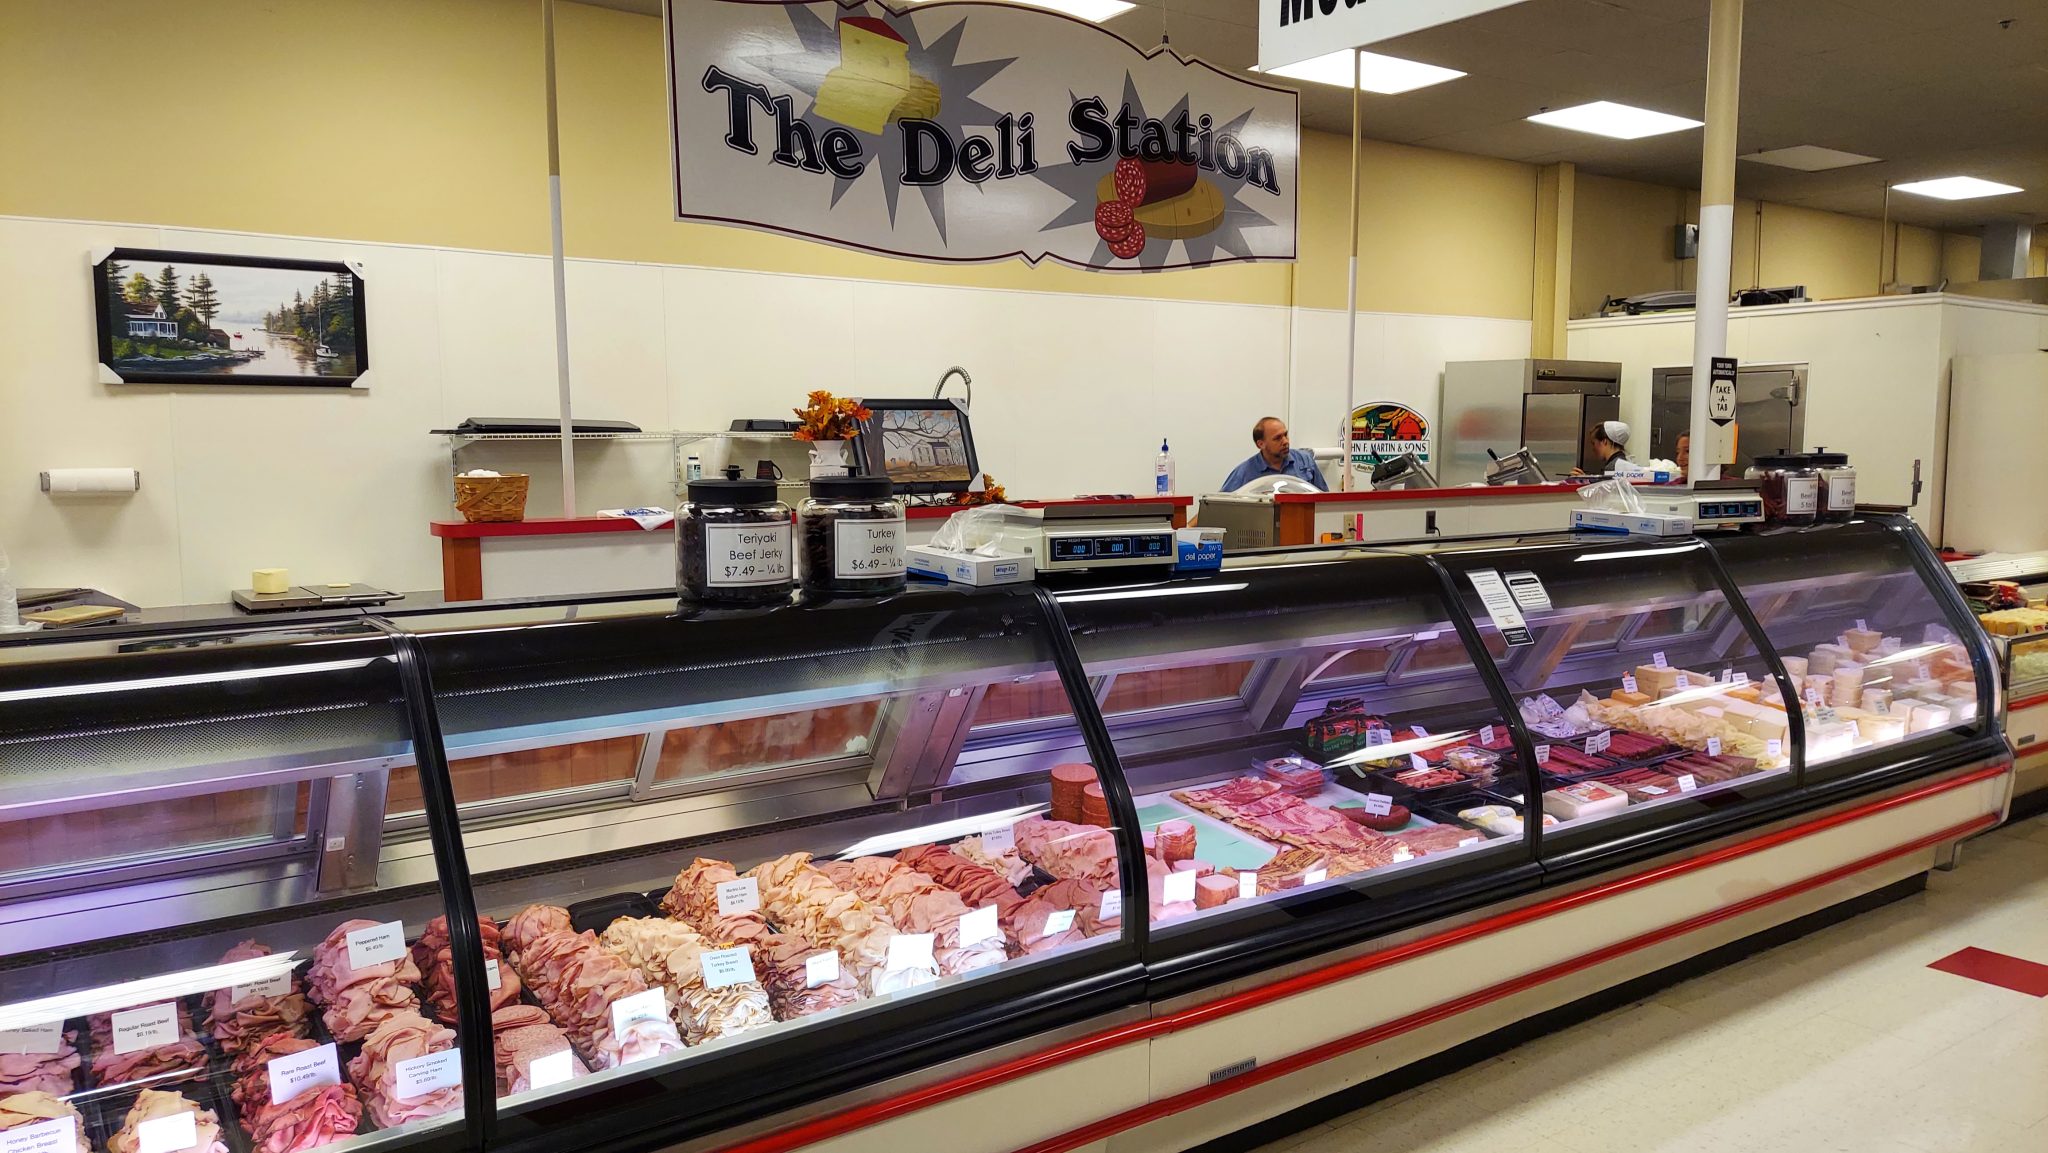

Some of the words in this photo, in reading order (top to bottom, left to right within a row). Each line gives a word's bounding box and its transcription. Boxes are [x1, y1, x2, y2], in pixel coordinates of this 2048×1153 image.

[701, 64, 866, 180] The
[898, 111, 1039, 187] Deli
[1067, 96, 1282, 197] Station
[1716, 386, 1731, 394] TAKE
[1371, 443, 1395, 452] MARTIN
[1404, 443, 1426, 452] SONS
[738, 533, 777, 545] Teriyaki
[867, 530, 896, 540] Turkey
[729, 550, 756, 560] Beef
[760, 548, 782, 560] Jerky
[870, 544, 894, 554] Jerky
[1198, 553, 1216, 562] paper
[852, 558, 880, 570] $6.49
[724, 566, 755, 578] $7.49
[356, 937, 378, 946] Peppered
[118, 1024, 140, 1032] Regular
[157, 1017, 170, 1025] Beef
[296, 1064, 312, 1072] Roast
[313, 1060, 326, 1068] Beef
[426, 1058, 448, 1067] Smoked
[6, 1137, 28, 1145] Honey
[30, 1129, 62, 1140] Barbecue
